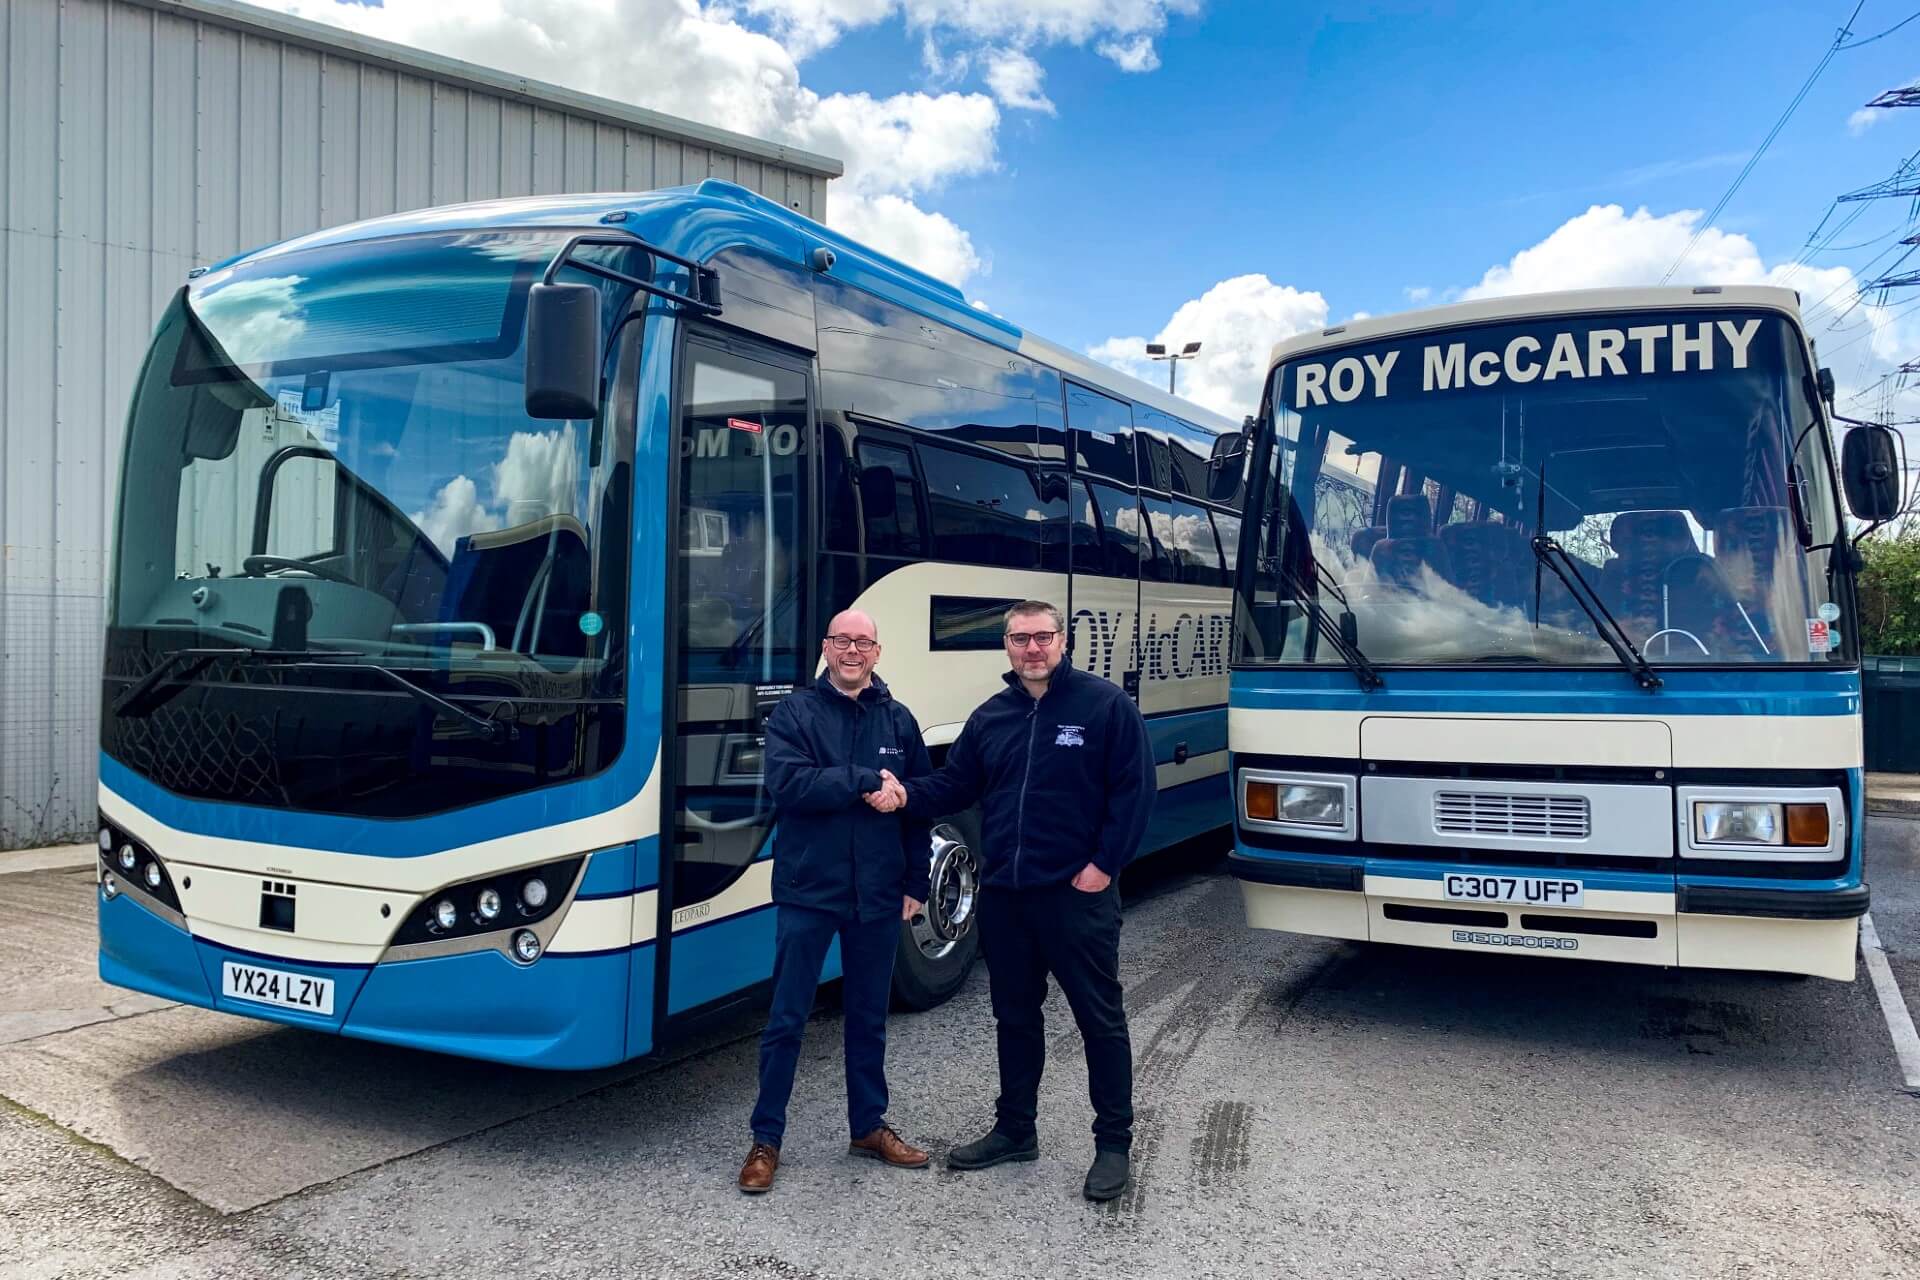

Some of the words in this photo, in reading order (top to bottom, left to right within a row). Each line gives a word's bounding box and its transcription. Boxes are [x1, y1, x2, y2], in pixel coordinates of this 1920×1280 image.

[1295, 350, 1400, 408] ROY
[1423, 319, 1762, 391] McCARTHY
[1071, 609, 1122, 680] OY
[1448, 876, 1517, 900] C307
[1524, 879, 1579, 903] UFP
[674, 903, 710, 924] LEOPARD
[1452, 929, 1579, 951] BEDFORD
[231, 966, 280, 1000] YX24
[286, 976, 325, 1008] LZV
